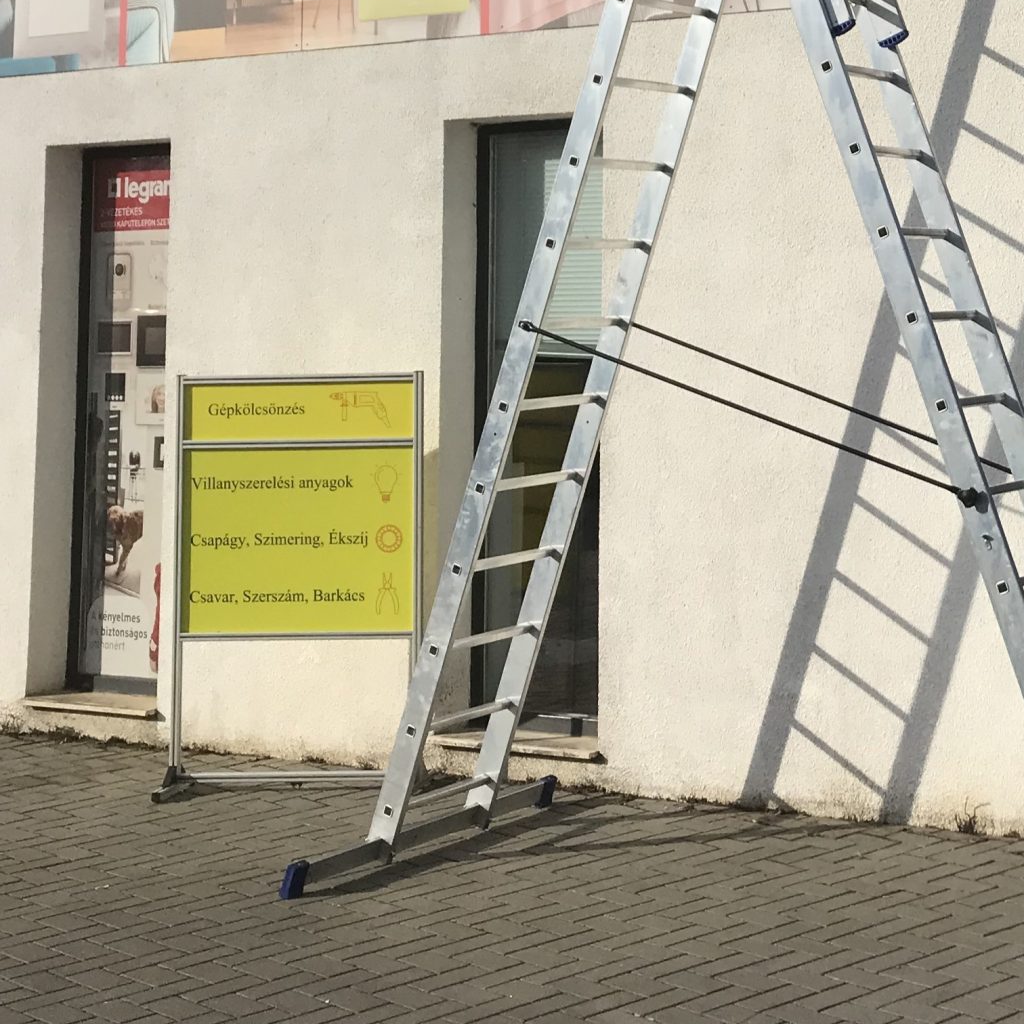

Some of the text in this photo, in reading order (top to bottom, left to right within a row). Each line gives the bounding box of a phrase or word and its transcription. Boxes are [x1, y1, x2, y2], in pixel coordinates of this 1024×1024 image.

[208, 402, 305, 419] Gépkölcsönzés
[191, 475, 353, 493] Villanyszerelési anyagok
[190, 528, 369, 550] Csapágy, Szimering, Ékszíj
[189, 588, 366, 605] Csavar, Szerszám, Barkács
